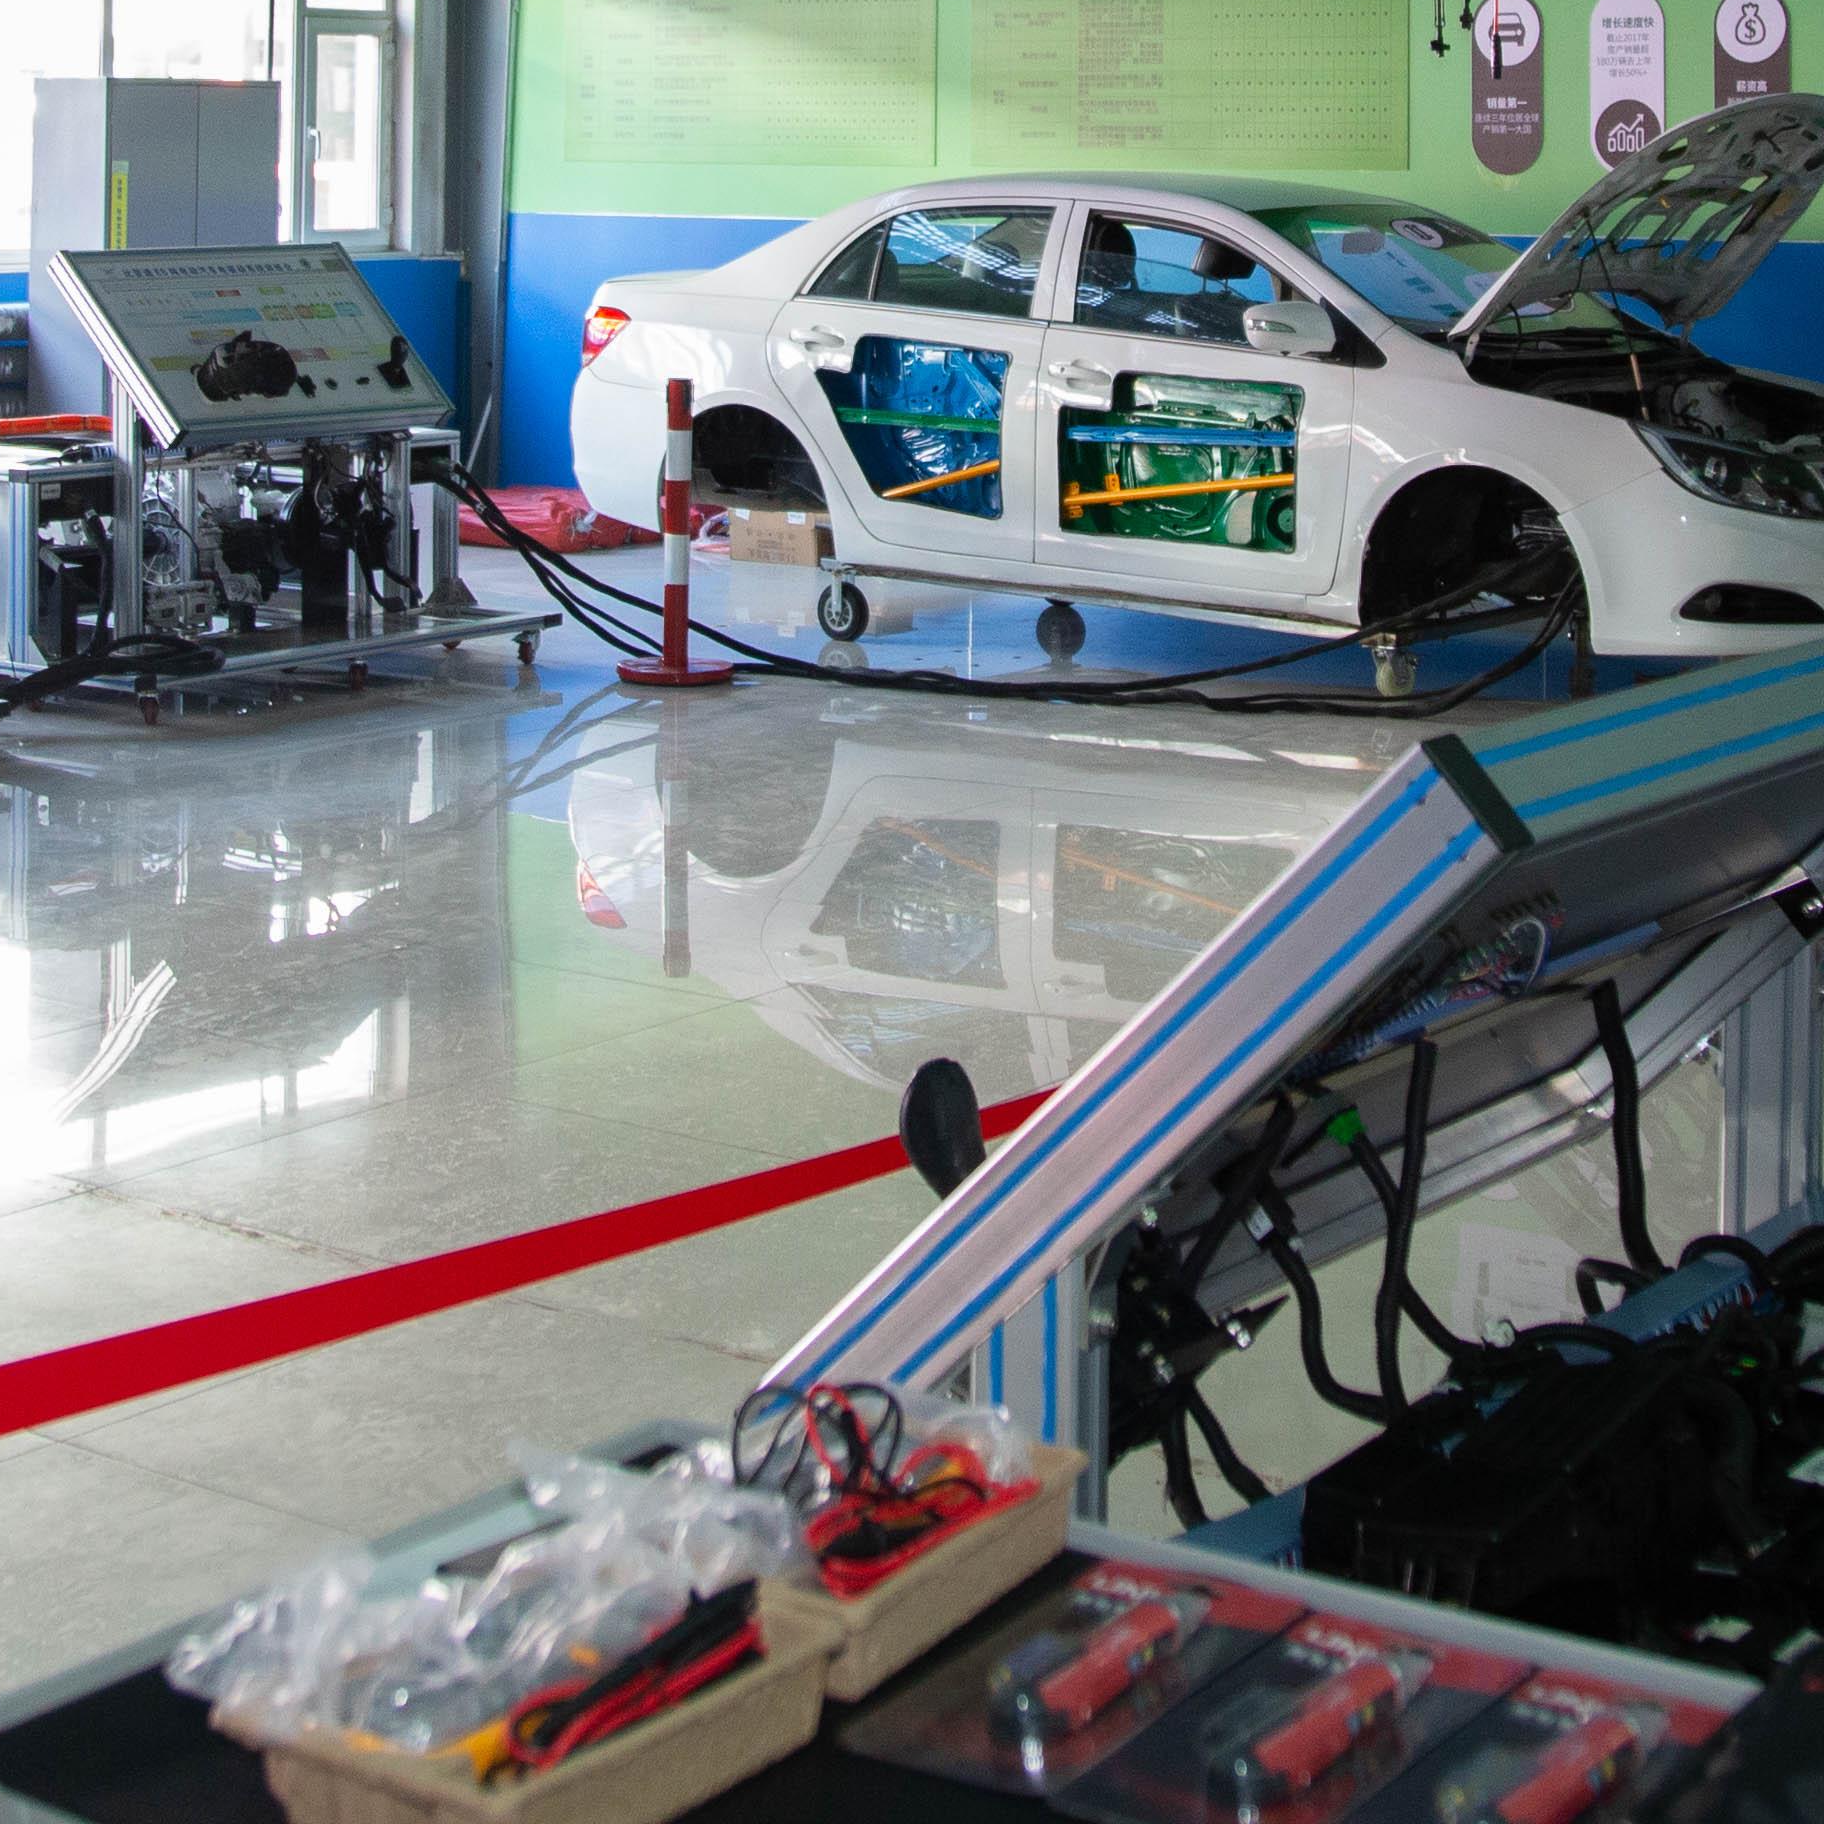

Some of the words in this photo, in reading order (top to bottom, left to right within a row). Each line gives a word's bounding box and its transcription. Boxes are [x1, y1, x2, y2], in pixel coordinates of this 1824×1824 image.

[1602, 17, 1655, 29] 增长速度快
[1735, 80, 1768, 93] 薪资高
[1486, 96, 1528, 109] 销量第一
